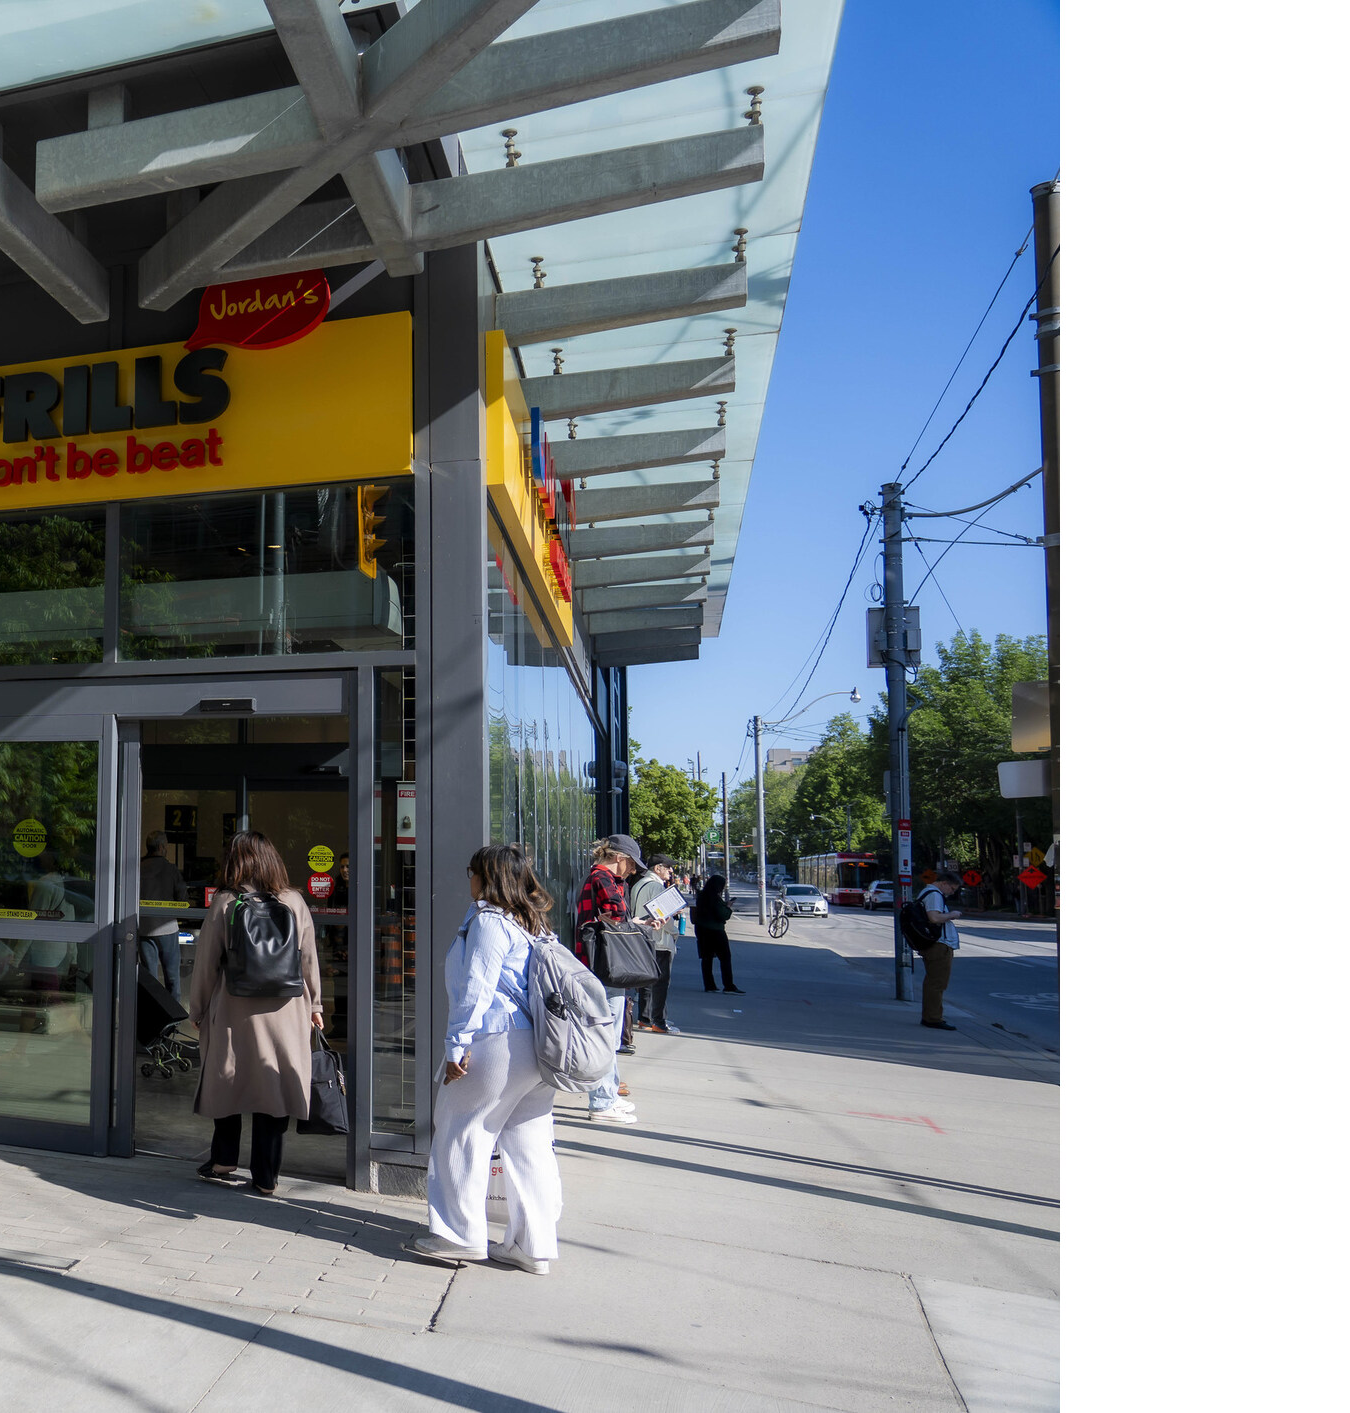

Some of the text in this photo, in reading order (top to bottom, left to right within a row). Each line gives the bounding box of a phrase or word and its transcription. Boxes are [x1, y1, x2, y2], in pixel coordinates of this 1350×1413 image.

[210, 279, 319, 320] Jordan's
[66, 442, 119, 480] be
[126, 428, 223, 474] beat
[172, 809, 182, 827] 2
[14, 834, 46, 842] CAUTION
